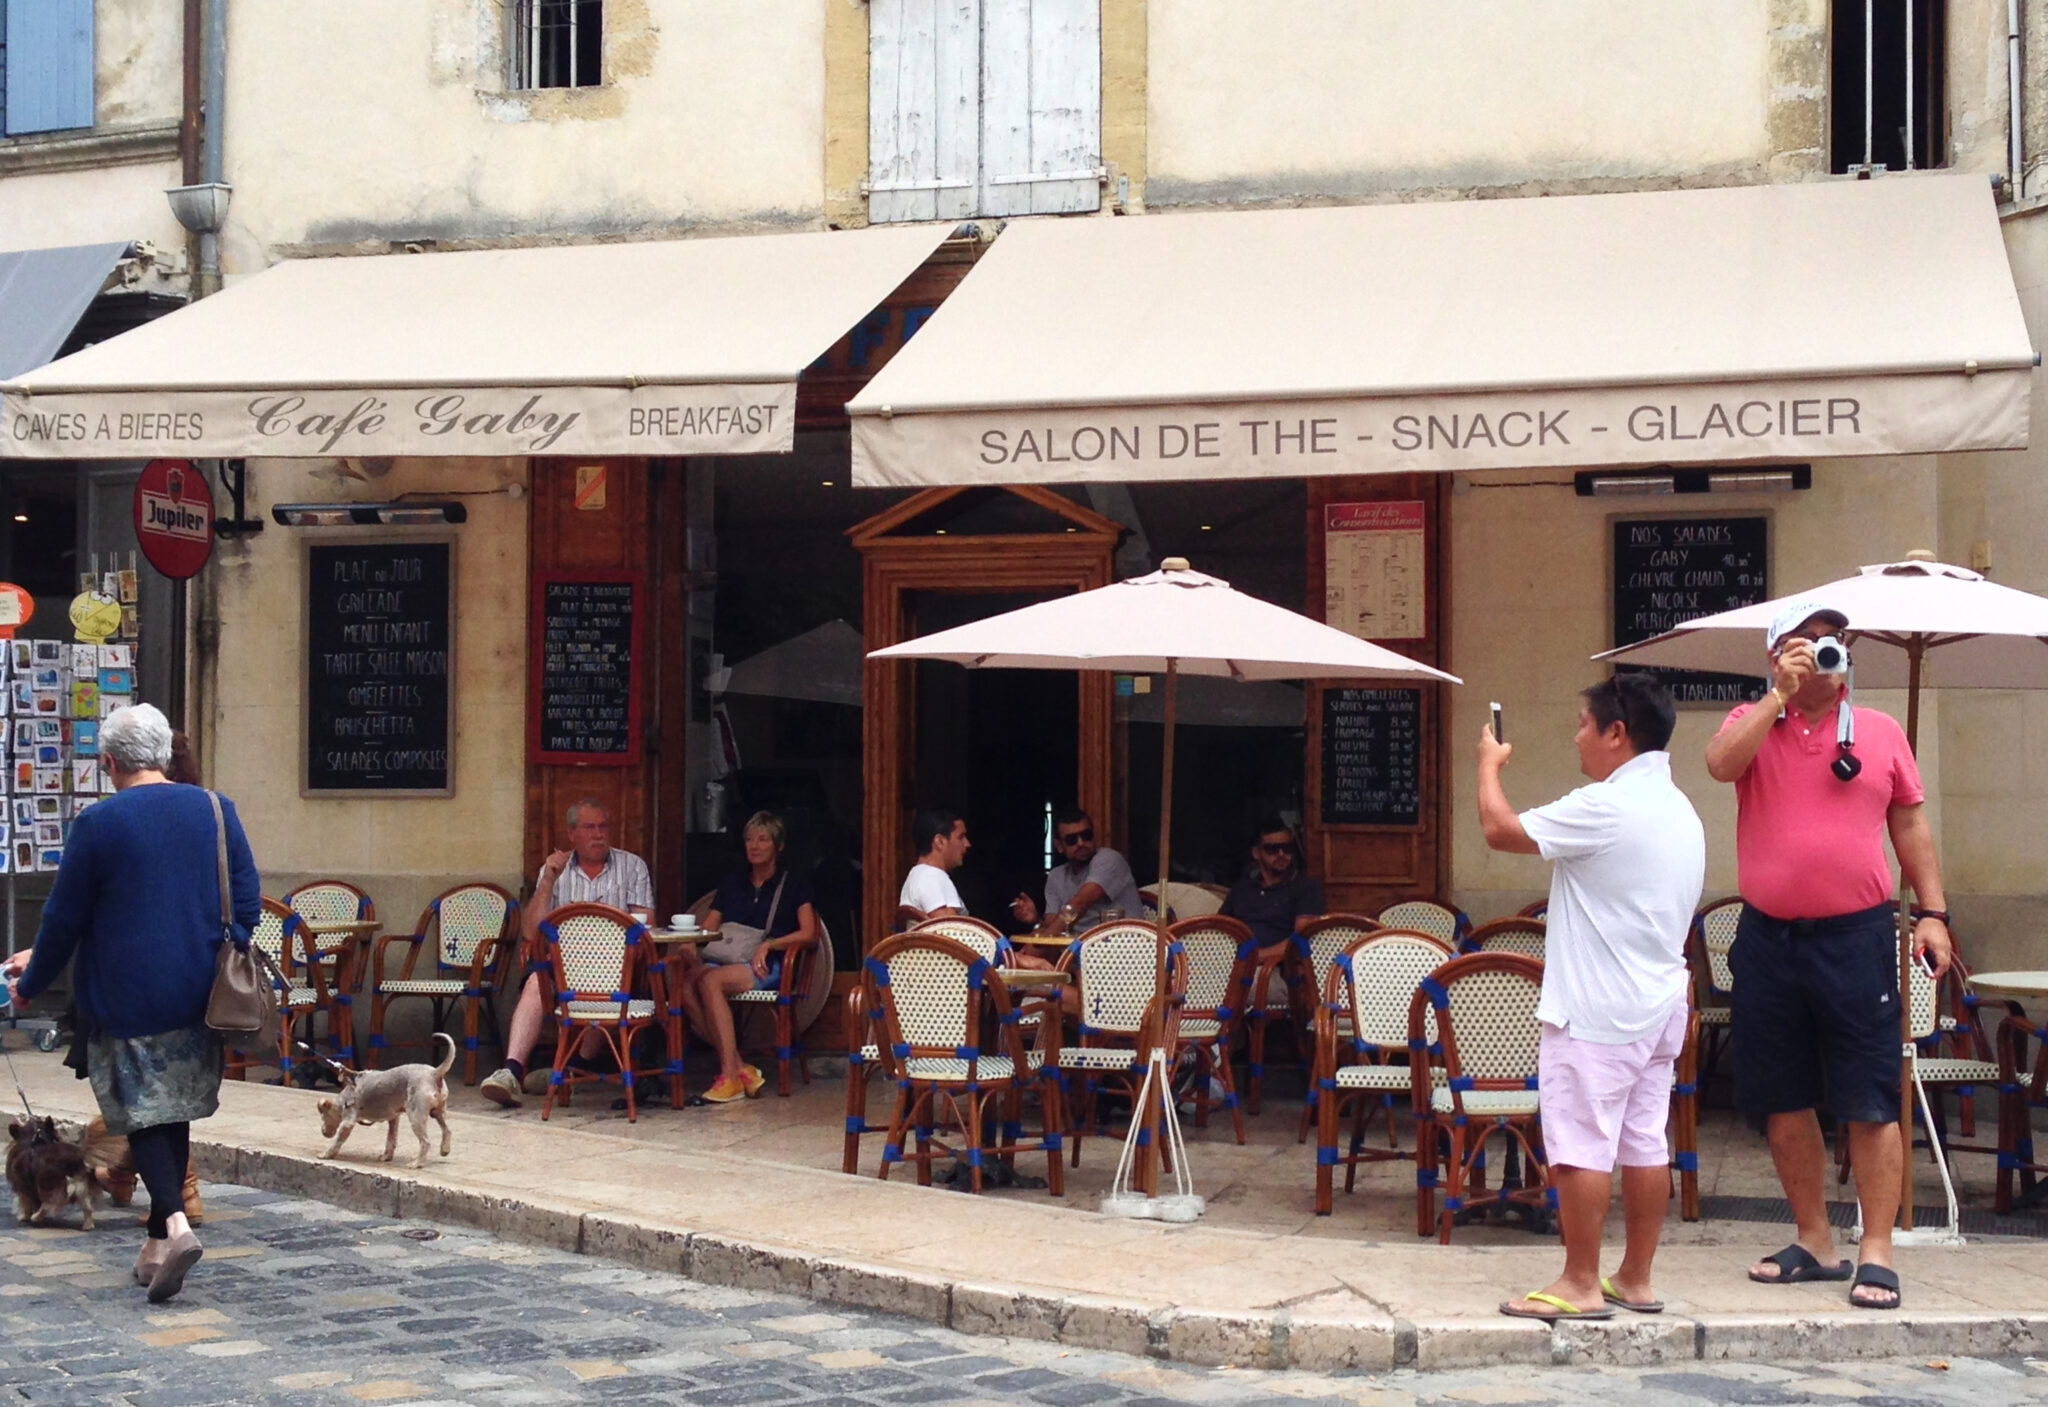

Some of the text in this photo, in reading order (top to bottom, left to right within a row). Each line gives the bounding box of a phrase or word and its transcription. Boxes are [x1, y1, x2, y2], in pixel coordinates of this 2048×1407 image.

[13, 413, 203, 440] CAVES A BIERES
[247, 395, 581, 453] Café Gaby
[629, 405, 779, 436] BREAKFAST
[979, 425, 1140, 464] SALON
[1158, 423, 1220, 459] DE
[1240, 419, 1337, 456] THE
[1391, 410, 1570, 451] SNACK
[1628, 398, 1861, 441] GLACIER
[147, 499, 204, 532] Jupiler
[1631, 526, 1732, 543] NOS SALADES
[1650, 550, 1689, 567] GABY
[334, 560, 368, 582] PLAT
[390, 558, 422, 582] JOUR
[1629, 572, 1675, 587] CHEVRE
[1684, 571, 1726, 586] CHAUD
[337, 591, 404, 613] GRILLADE
[344, 621, 431, 643] MENU ENFANT
[323, 653, 364, 675] TARTE
[327, 751, 380, 771] SALADES
